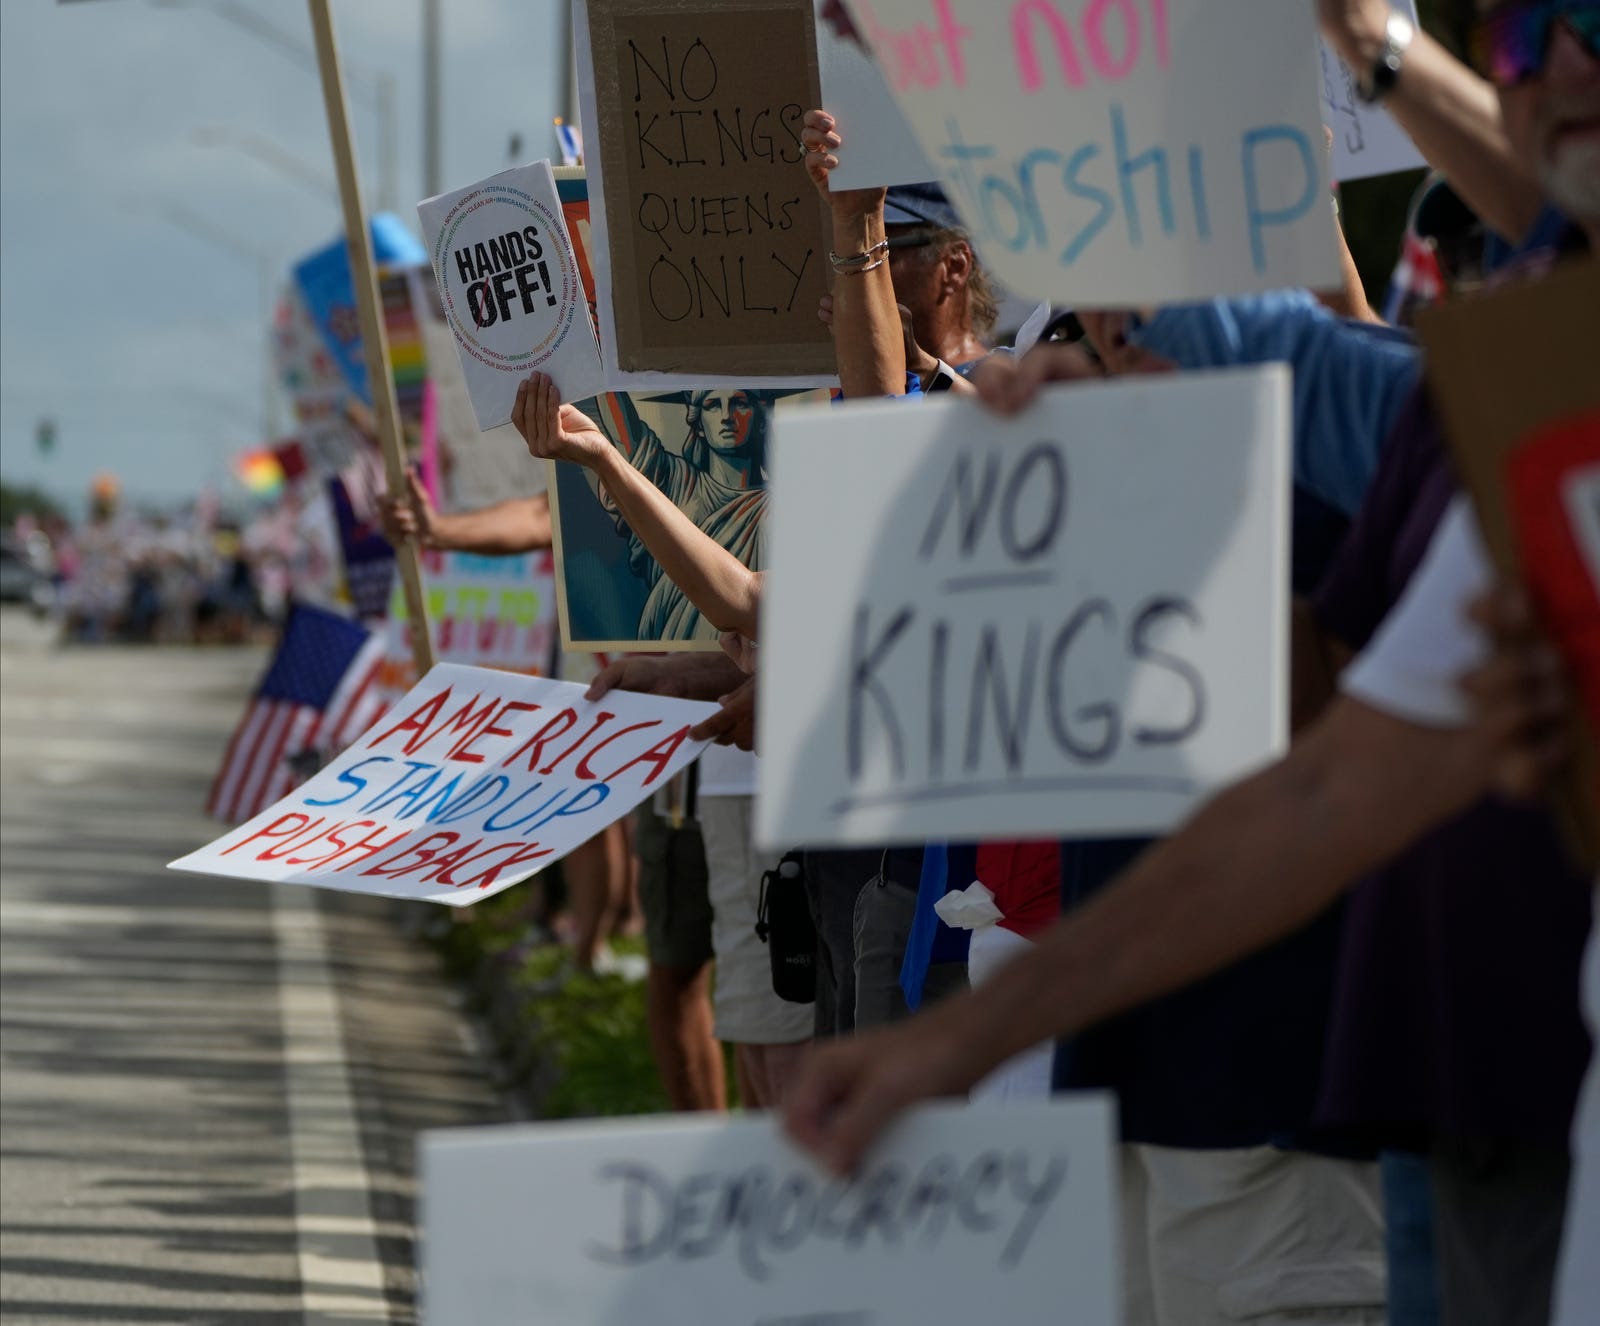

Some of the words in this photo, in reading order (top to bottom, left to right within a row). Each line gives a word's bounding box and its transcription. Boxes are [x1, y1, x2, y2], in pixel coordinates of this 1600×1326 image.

[628, 35, 717, 101] NO
[634, 103, 807, 168] KINGS
[458, 190, 481, 208] SECURITY
[484, 185, 506, 193] VETERAN
[507, 187, 531, 201] SERVICES
[445, 206, 459, 225] SOCIAL
[467, 202, 484, 213] CLEAN
[496, 197, 528, 211] IMMIGRANTS
[533, 200, 553, 219] CANCER
[446, 212, 467, 248] PROTECTIONS
[639, 192, 799, 251] QUEENS
[552, 219, 571, 251] RESEARCH
[454, 225, 543, 284] HANDS
[466, 260, 557, 328] OFF!
[649, 249, 813, 321] ONLY
[445, 291, 454, 310] NATO
[567, 307, 575, 323] DATA
[454, 330, 463, 343] OUR
[552, 324, 571, 351] PERSONAL
[462, 342, 482, 361] WALLETS
[482, 347, 504, 360] SCHOOLS
[528, 351, 552, 368] ELECTIONS
[516, 363, 527, 371] FAIR
[918, 440, 1067, 564] NO
[846, 591, 1209, 783] KINGS
[366, 684, 693, 787] AMERICA
[220, 812, 413, 873] PUSH
[359, 832, 556, 889] BACK
[584, 1148, 1072, 1284] DEMOCRACY
